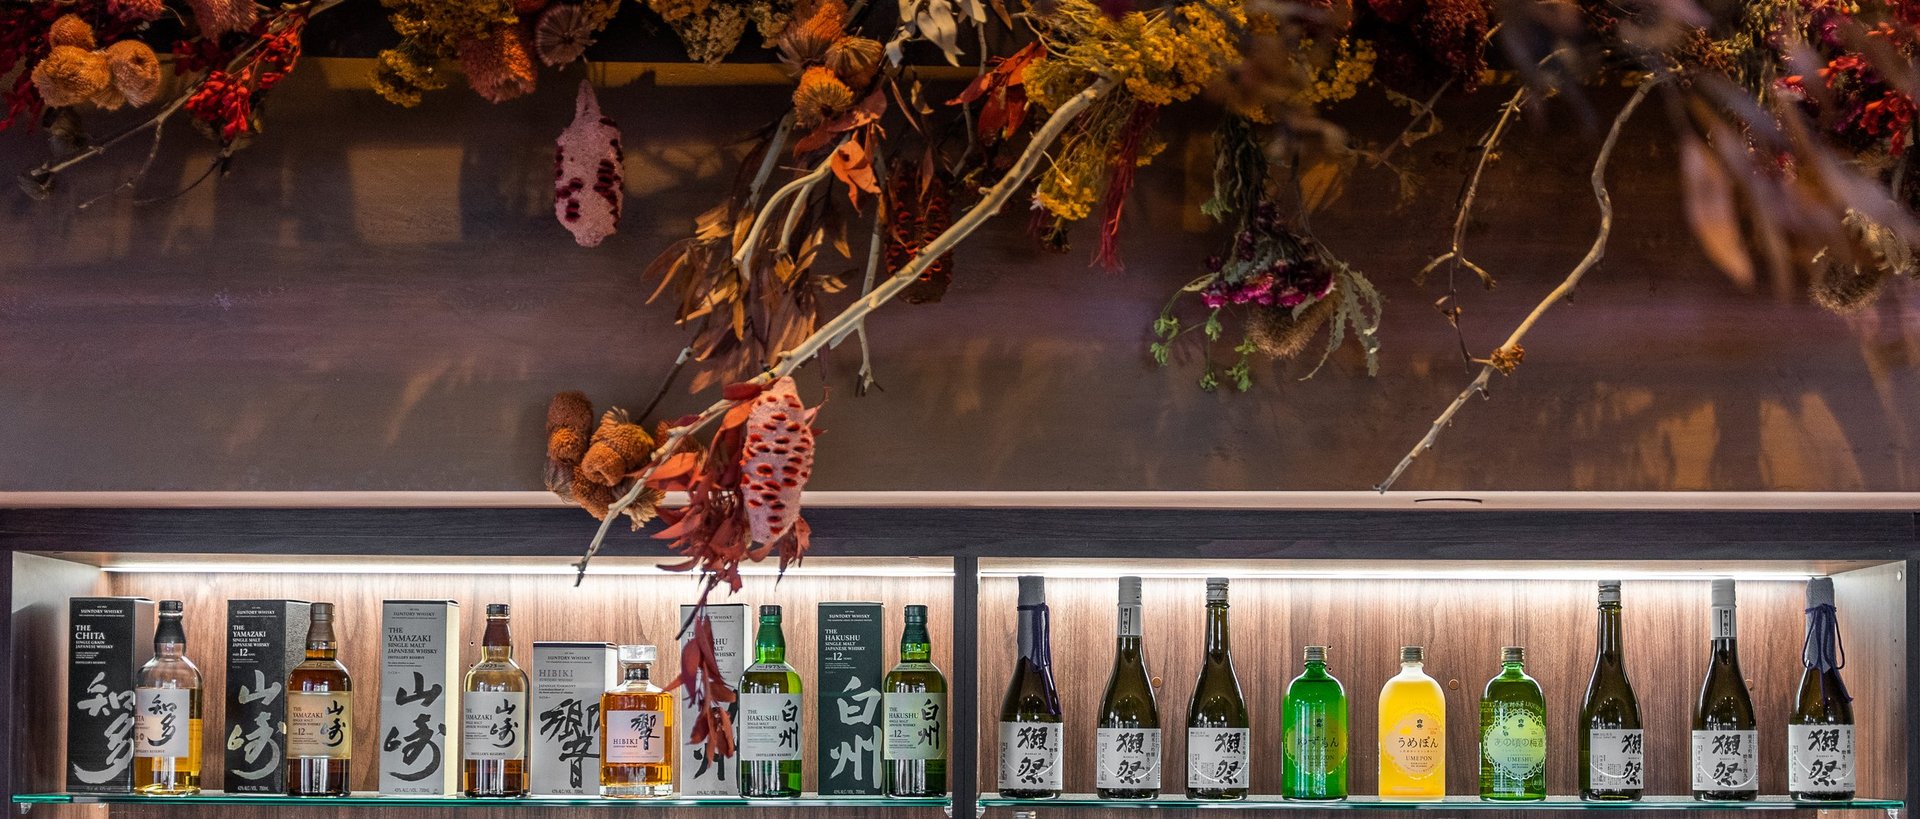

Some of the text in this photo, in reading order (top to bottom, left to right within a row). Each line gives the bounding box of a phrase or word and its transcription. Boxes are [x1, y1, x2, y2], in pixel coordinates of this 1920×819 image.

[75, 624, 91, 632] THE
[75, 632, 105, 640] CHITA
[388, 634, 431, 642] YAMAZAKI
[239, 648, 248, 657] 12
[833, 652, 843, 661] 12
[539, 669, 574, 677] HIBIKI
[147, 694, 177, 746] 知多
[918, 698, 940, 750] 白州
[779, 699, 799, 752] 白州
[297, 727, 306, 735] 12
[630, 713, 660, 750] 響
[829, 676, 882, 789] 白州
[893, 729, 902, 738] 12
[1398, 735, 1438, 748] うめぽん
